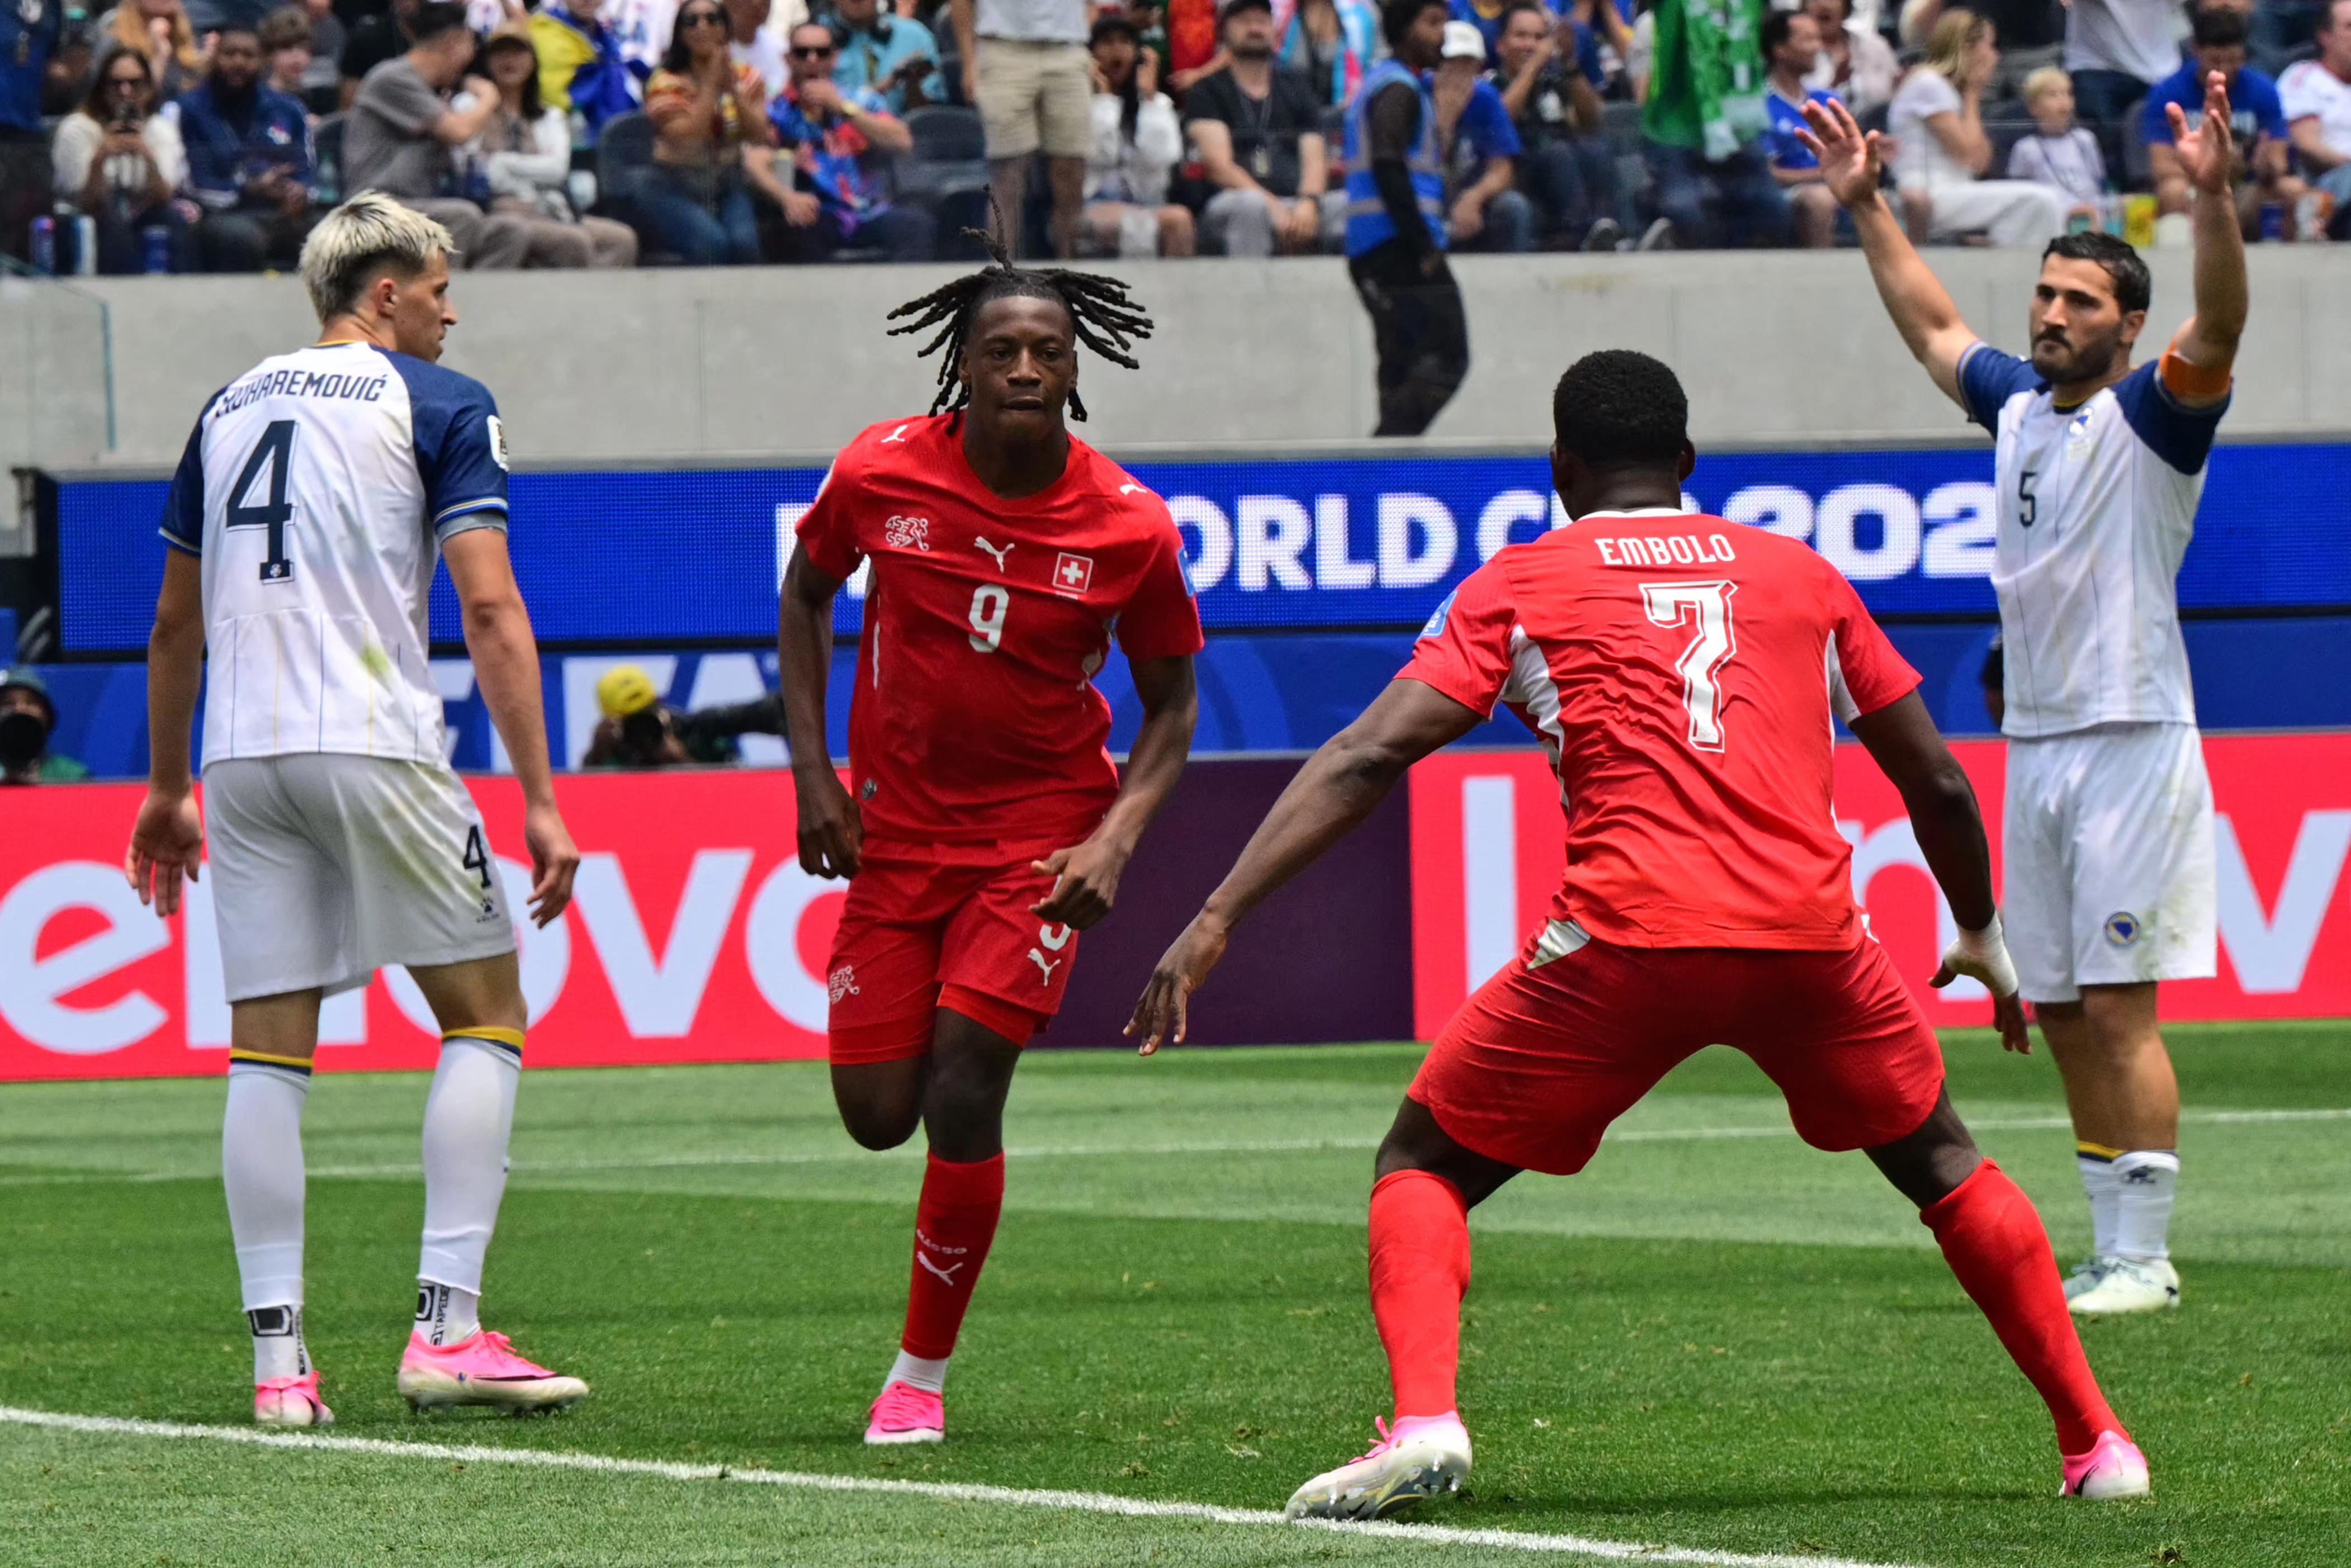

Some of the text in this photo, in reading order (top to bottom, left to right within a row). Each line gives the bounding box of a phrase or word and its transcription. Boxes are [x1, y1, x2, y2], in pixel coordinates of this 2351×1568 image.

[215, 370, 388, 418] MUHAREMOVIĆ
[226, 419, 299, 584] 4
[2018, 471, 2038, 527] 5
[1166, 490, 1458, 593] ORLD
[1722, 482, 1997, 580] 202
[1595, 533, 1735, 566] EMBOLO
[968, 584, 1010, 653] 9
[1638, 579, 1738, 754] 7
[463, 825, 491, 889] 4
